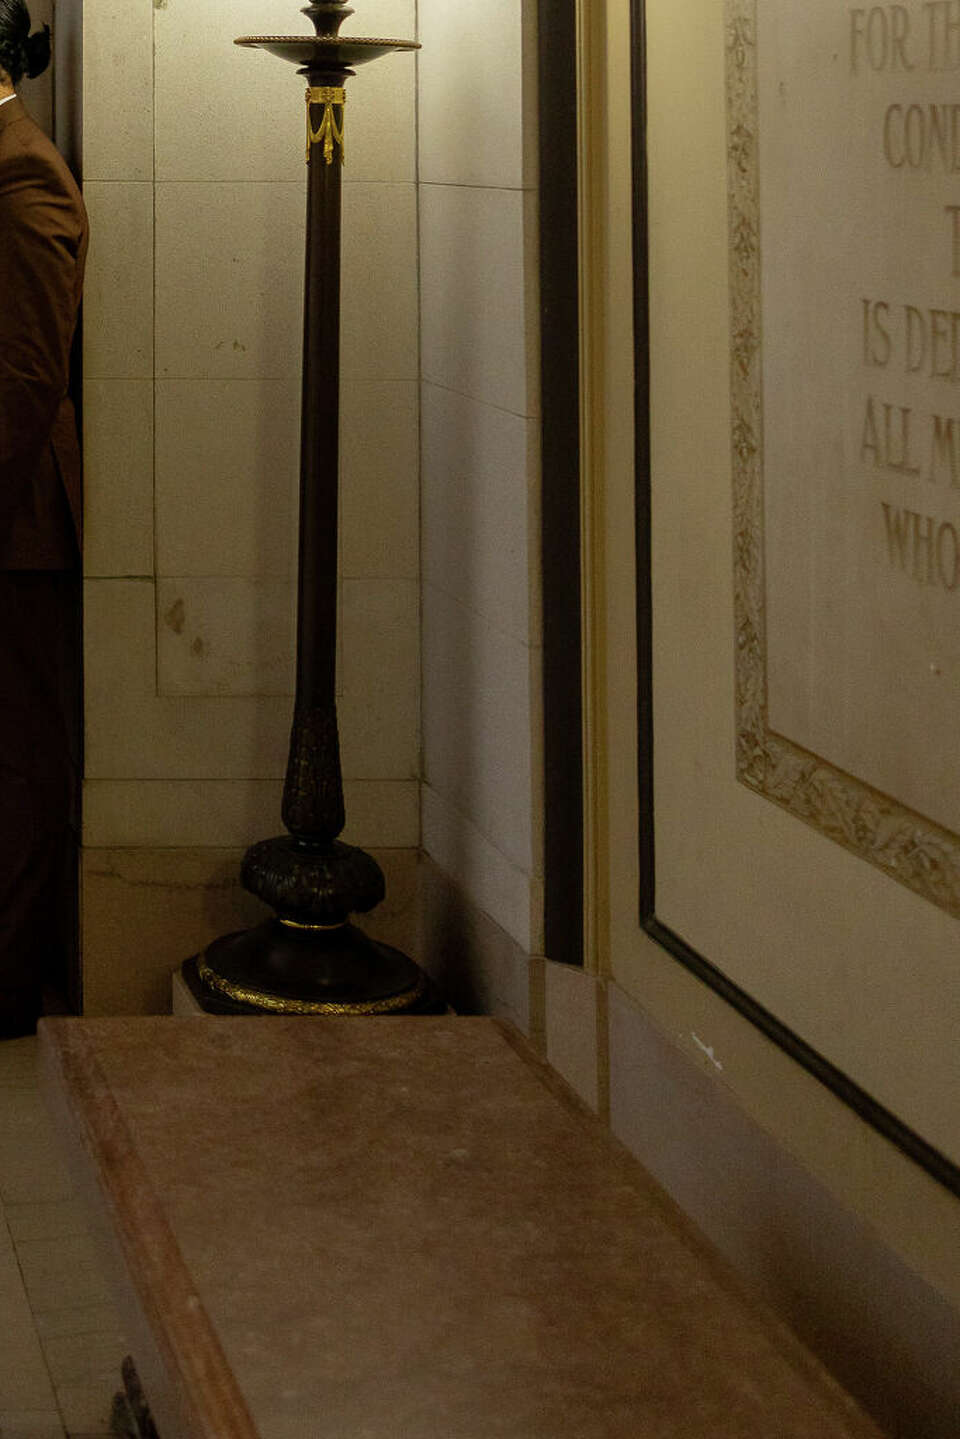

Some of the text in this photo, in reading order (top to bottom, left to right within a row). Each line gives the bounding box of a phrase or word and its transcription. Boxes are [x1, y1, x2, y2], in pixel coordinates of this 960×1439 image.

[850, 4, 916, 77] FOR
[861, 299, 891, 368] IS
[858, 394, 921, 476] ALL
